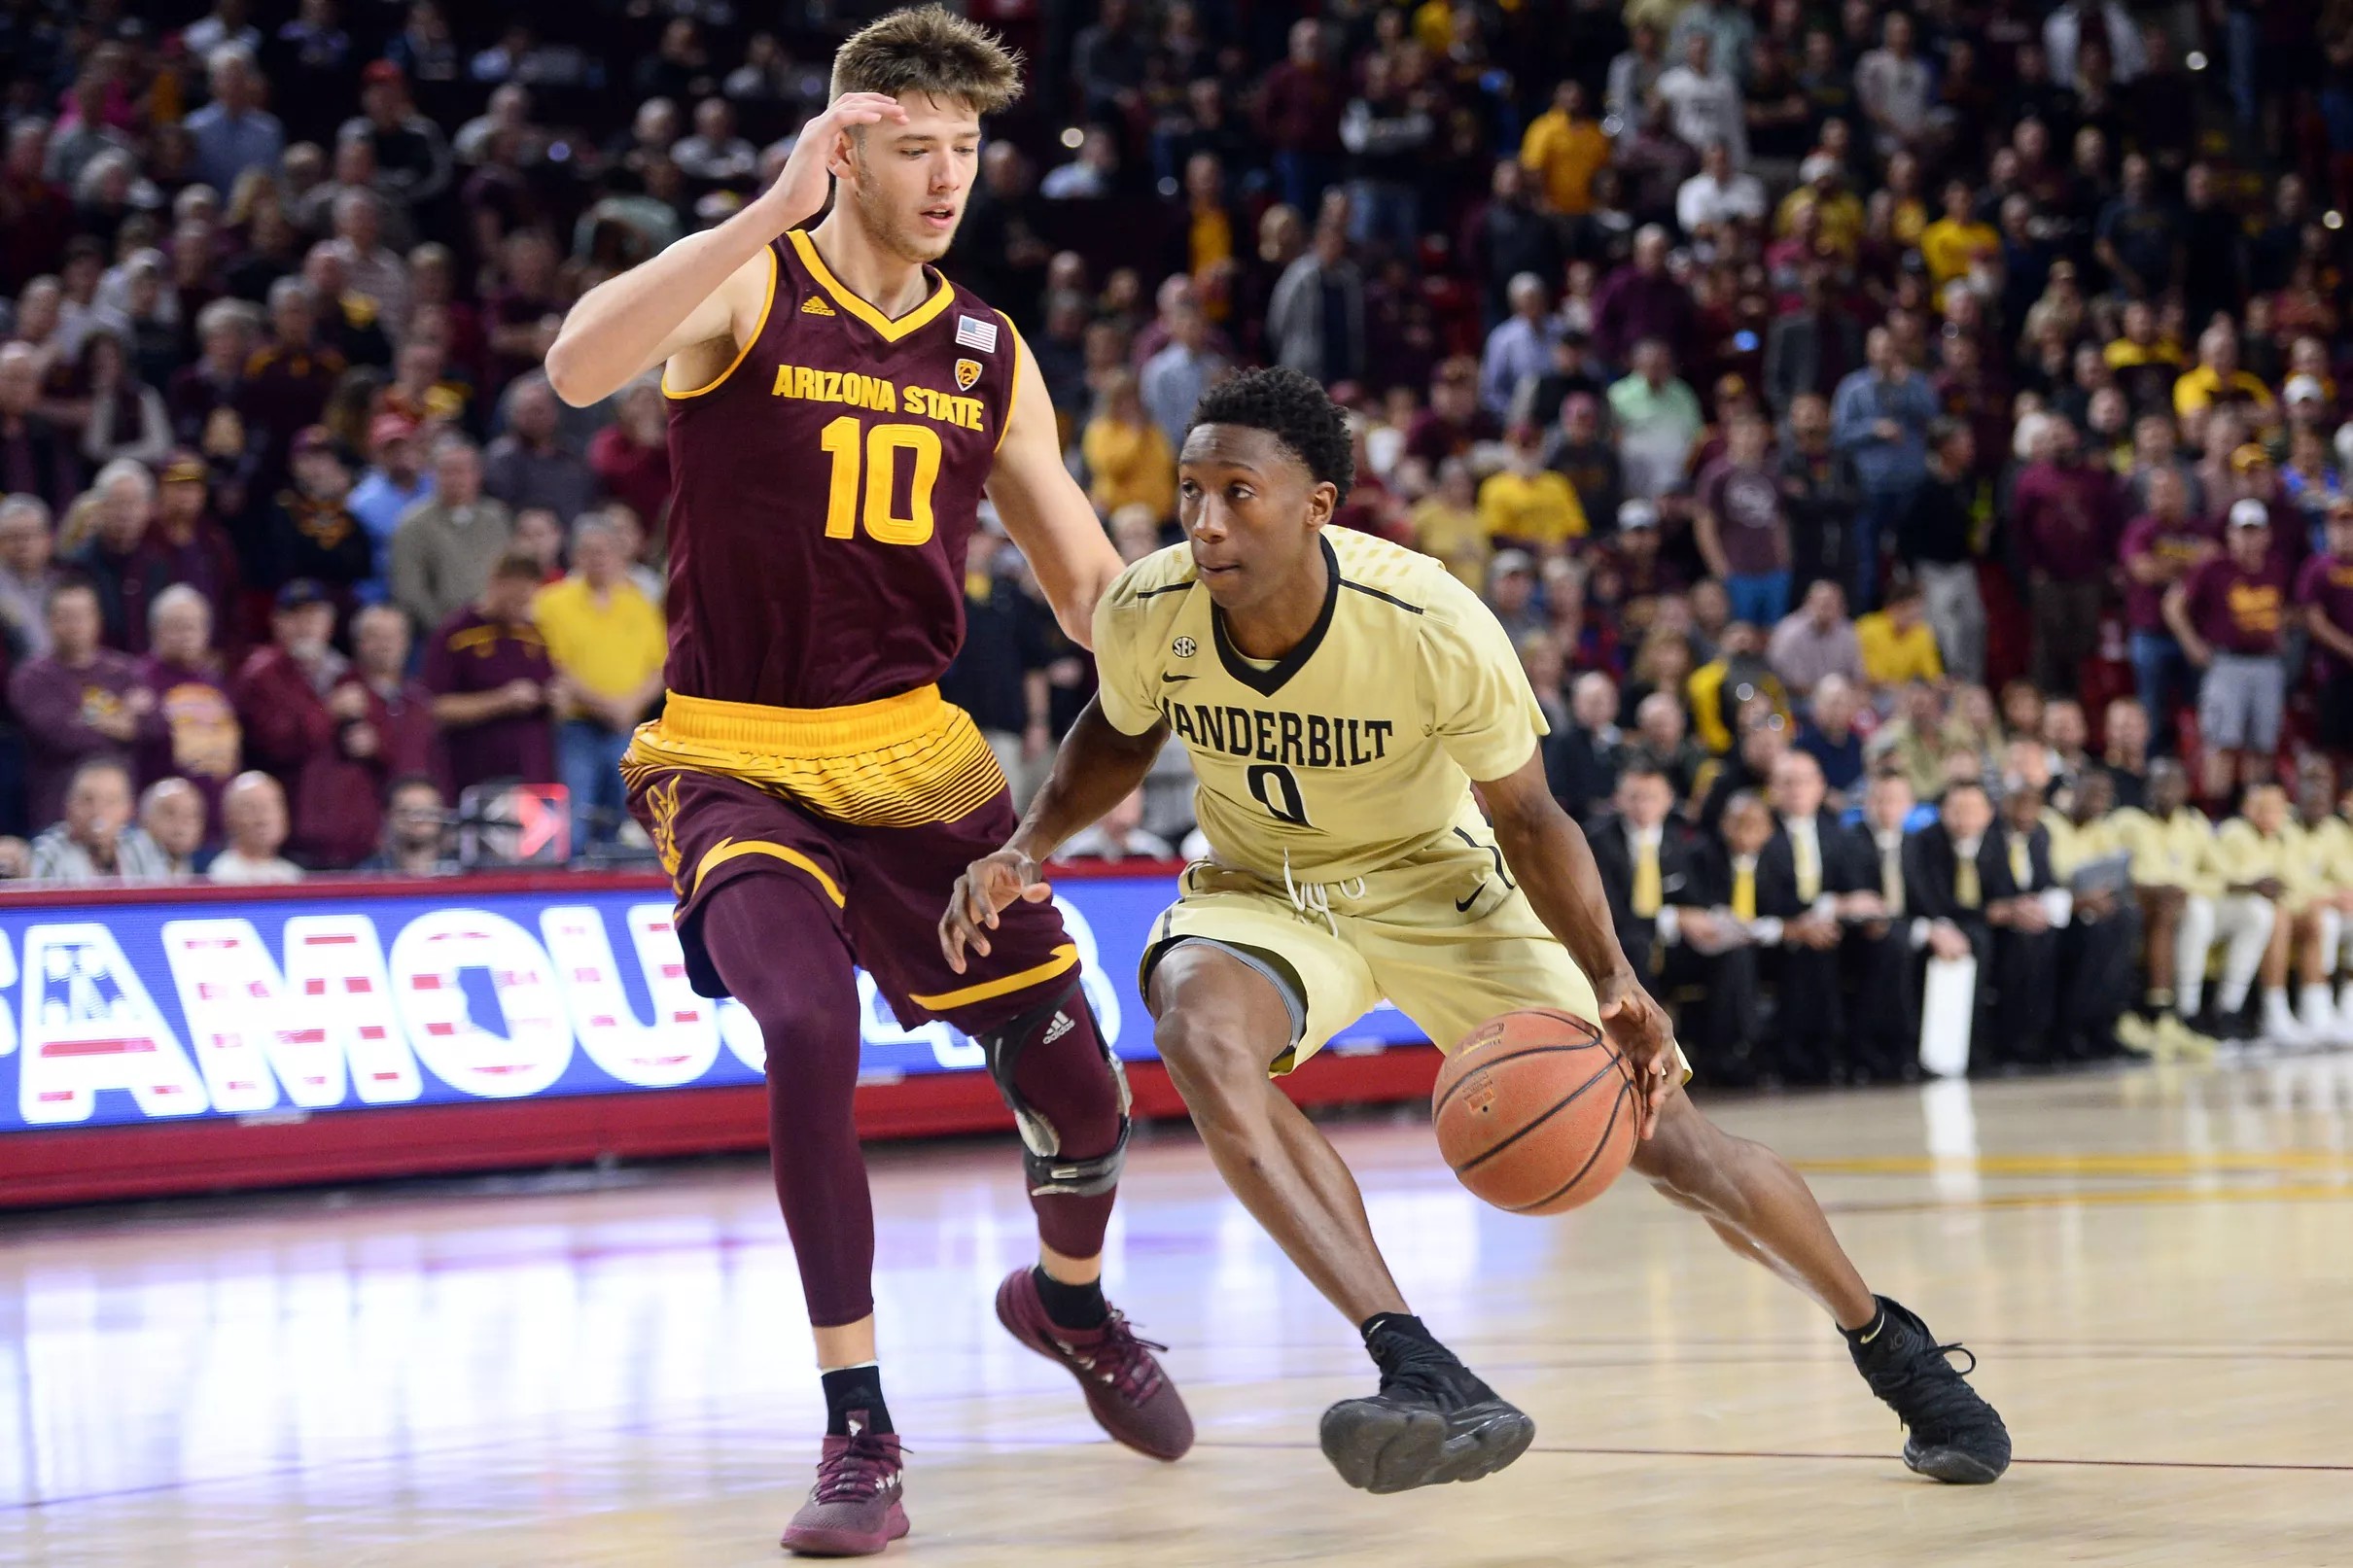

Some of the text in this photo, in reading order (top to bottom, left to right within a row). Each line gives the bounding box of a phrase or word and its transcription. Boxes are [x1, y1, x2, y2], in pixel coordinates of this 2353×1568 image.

[772, 365, 984, 432] ARIZONA STATE
[821, 416, 941, 545] 10
[1173, 637, 1196, 657] SEC
[1247, 764, 1313, 827] 0
[0, 904, 767, 1125] AMOU
